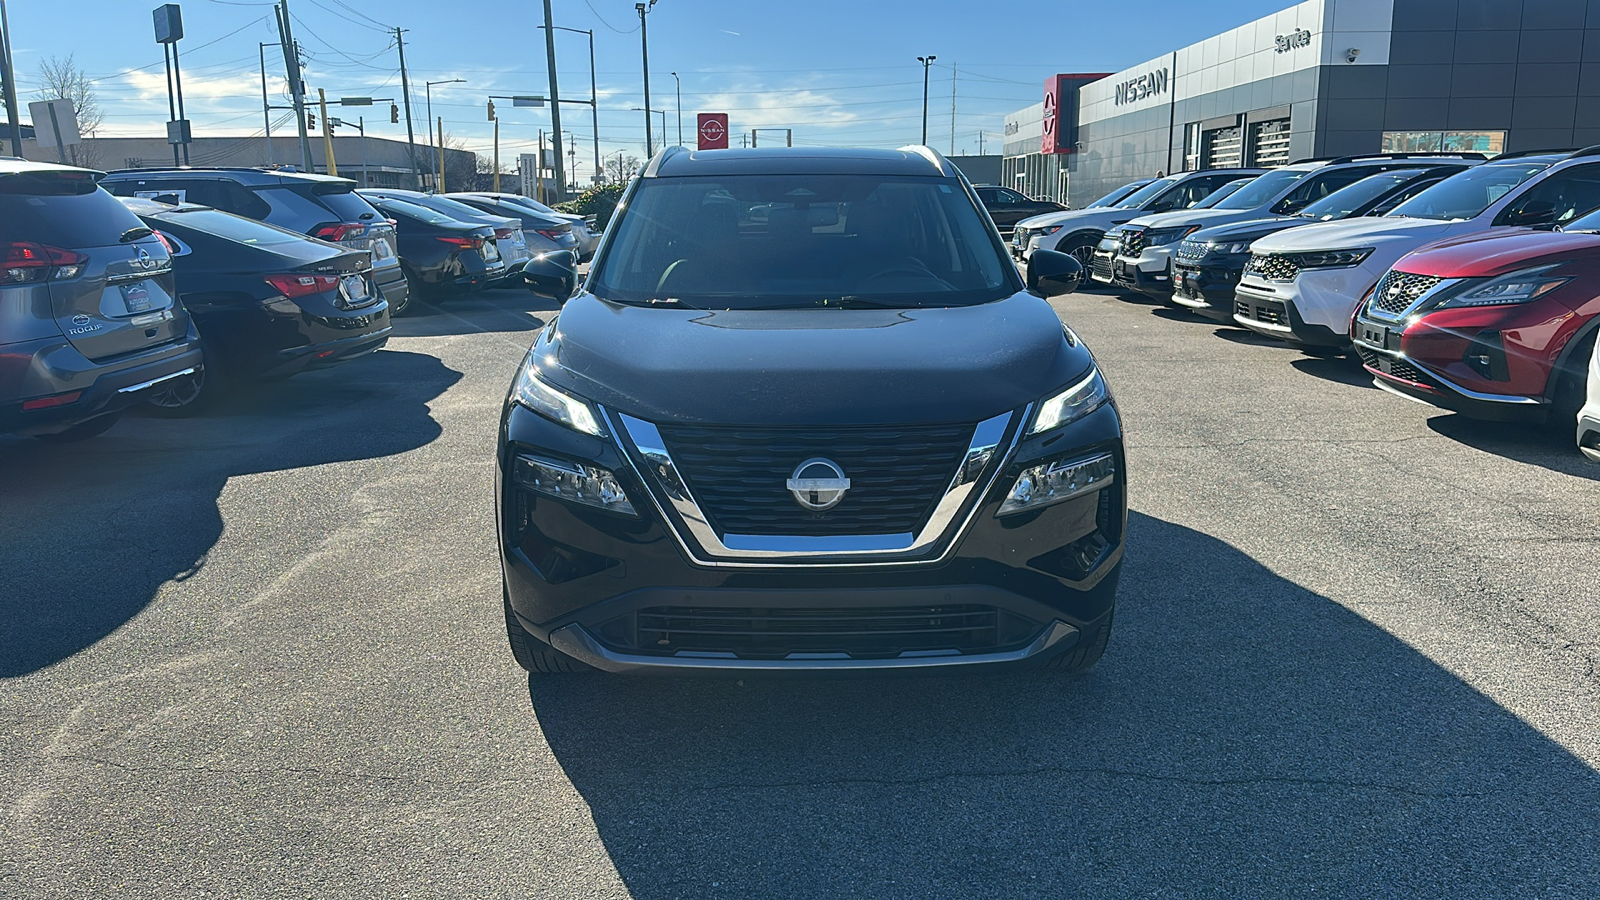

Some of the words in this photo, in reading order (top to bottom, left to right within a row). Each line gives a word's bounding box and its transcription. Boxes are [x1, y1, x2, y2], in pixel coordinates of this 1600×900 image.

[1275, 28, 1311, 54] Service
[1115, 67, 1168, 107] NISSAN
[69, 323, 103, 335] ROGUE
[788, 480, 848, 489] NISSAN
